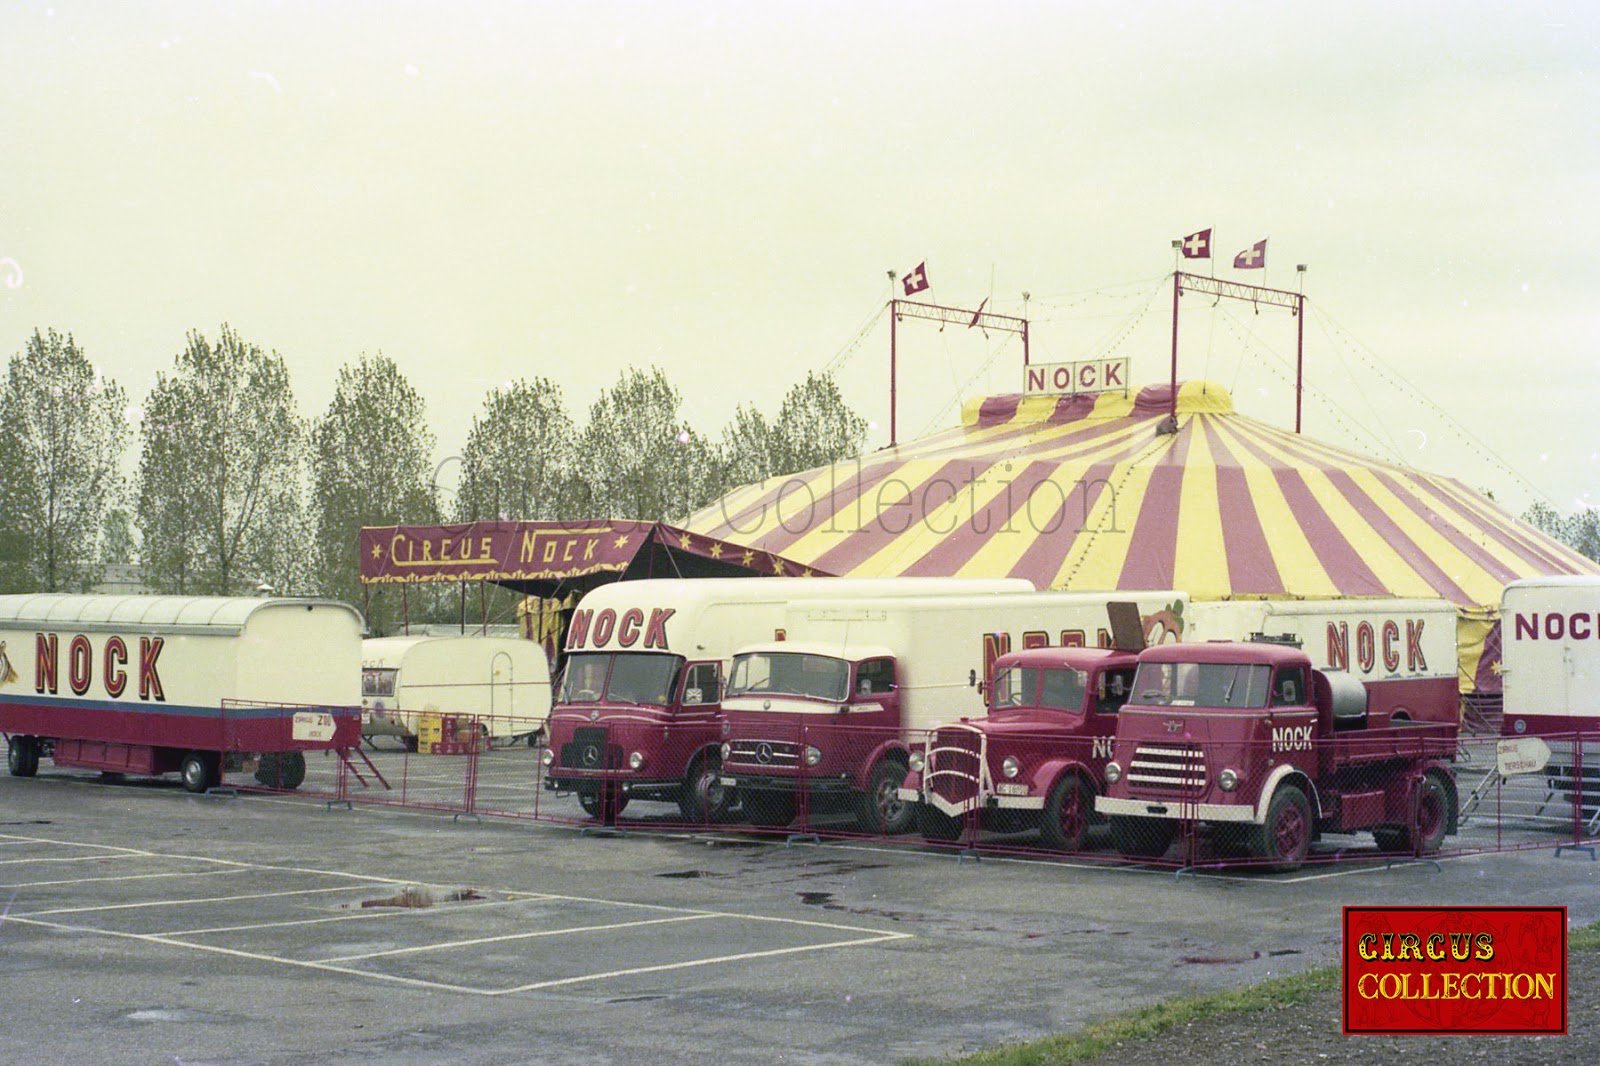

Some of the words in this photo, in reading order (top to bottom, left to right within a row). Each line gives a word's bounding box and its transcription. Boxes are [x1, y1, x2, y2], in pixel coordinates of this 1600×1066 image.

[1028, 362, 1122, 391] NOCK
[391, 533, 499, 566] CIRCUS
[520, 528, 612, 563] NOCK
[567, 607, 676, 649] NOCK
[1515, 612, 1600, 640] NOC
[1326, 618, 1428, 674] NOCK
[35, 632, 166, 701] NOCK
[1272, 726, 1313, 752] NOCK
